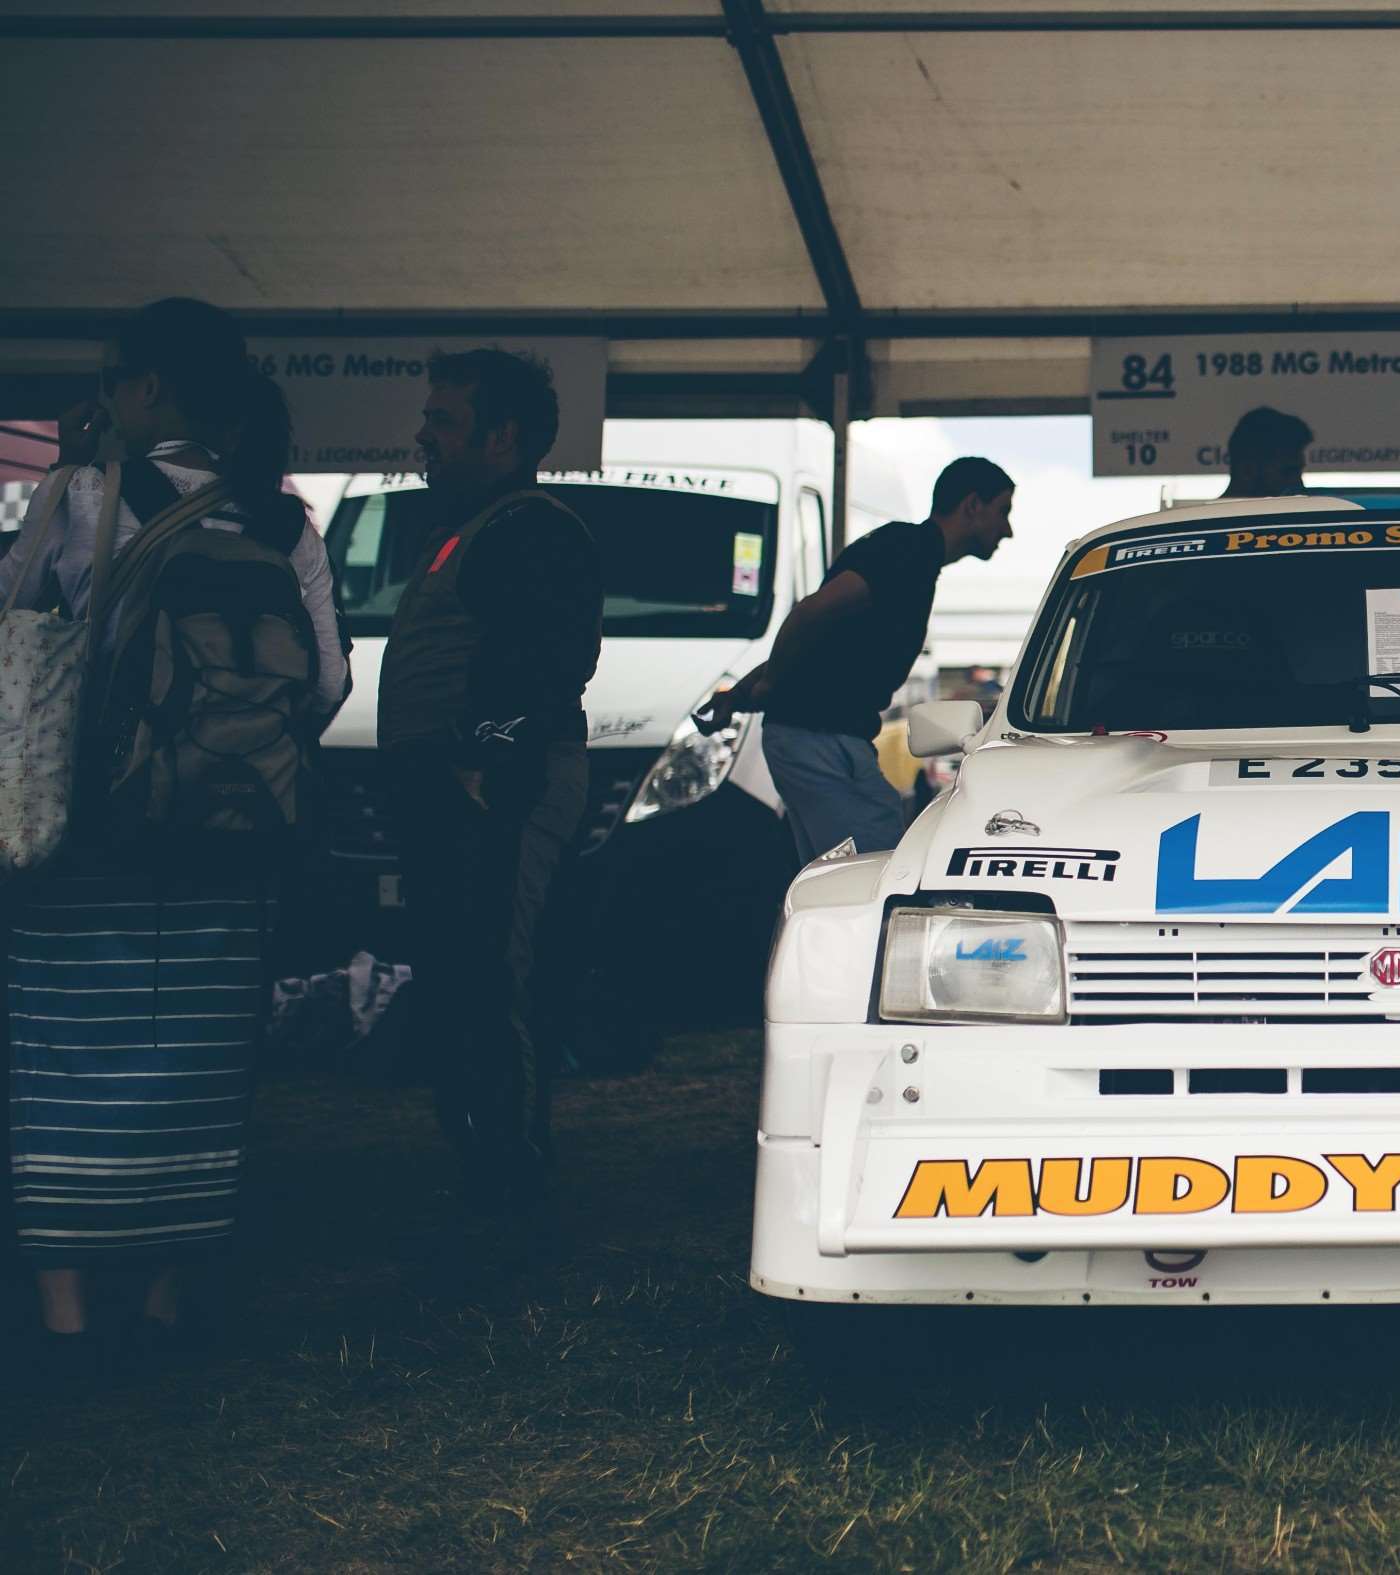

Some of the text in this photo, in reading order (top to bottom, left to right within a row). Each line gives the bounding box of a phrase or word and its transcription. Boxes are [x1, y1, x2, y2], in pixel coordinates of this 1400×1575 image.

[286, 353, 335, 378] MG
[342, 353, 424, 378] Metro
[1121, 353, 1175, 390] 84
[1196, 351, 1264, 377] 1988
[1271, 350, 1321, 376] MG
[1110, 430, 1170, 444] SHELTER
[315, 447, 411, 464] LEGENDARY
[1125, 443, 1158, 466] 10
[1310, 447, 1400, 464] LEGENDARY
[623, 470, 736, 491] FRANCE
[1114, 538, 1206, 561] PIRELLI
[1225, 529, 1374, 551] Promo
[1170, 631, 1252, 649] sparco
[1238, 758, 1271, 779] E
[946, 846, 1121, 882] PIRELLI
[1148, 1276, 1199, 1289] TOW
